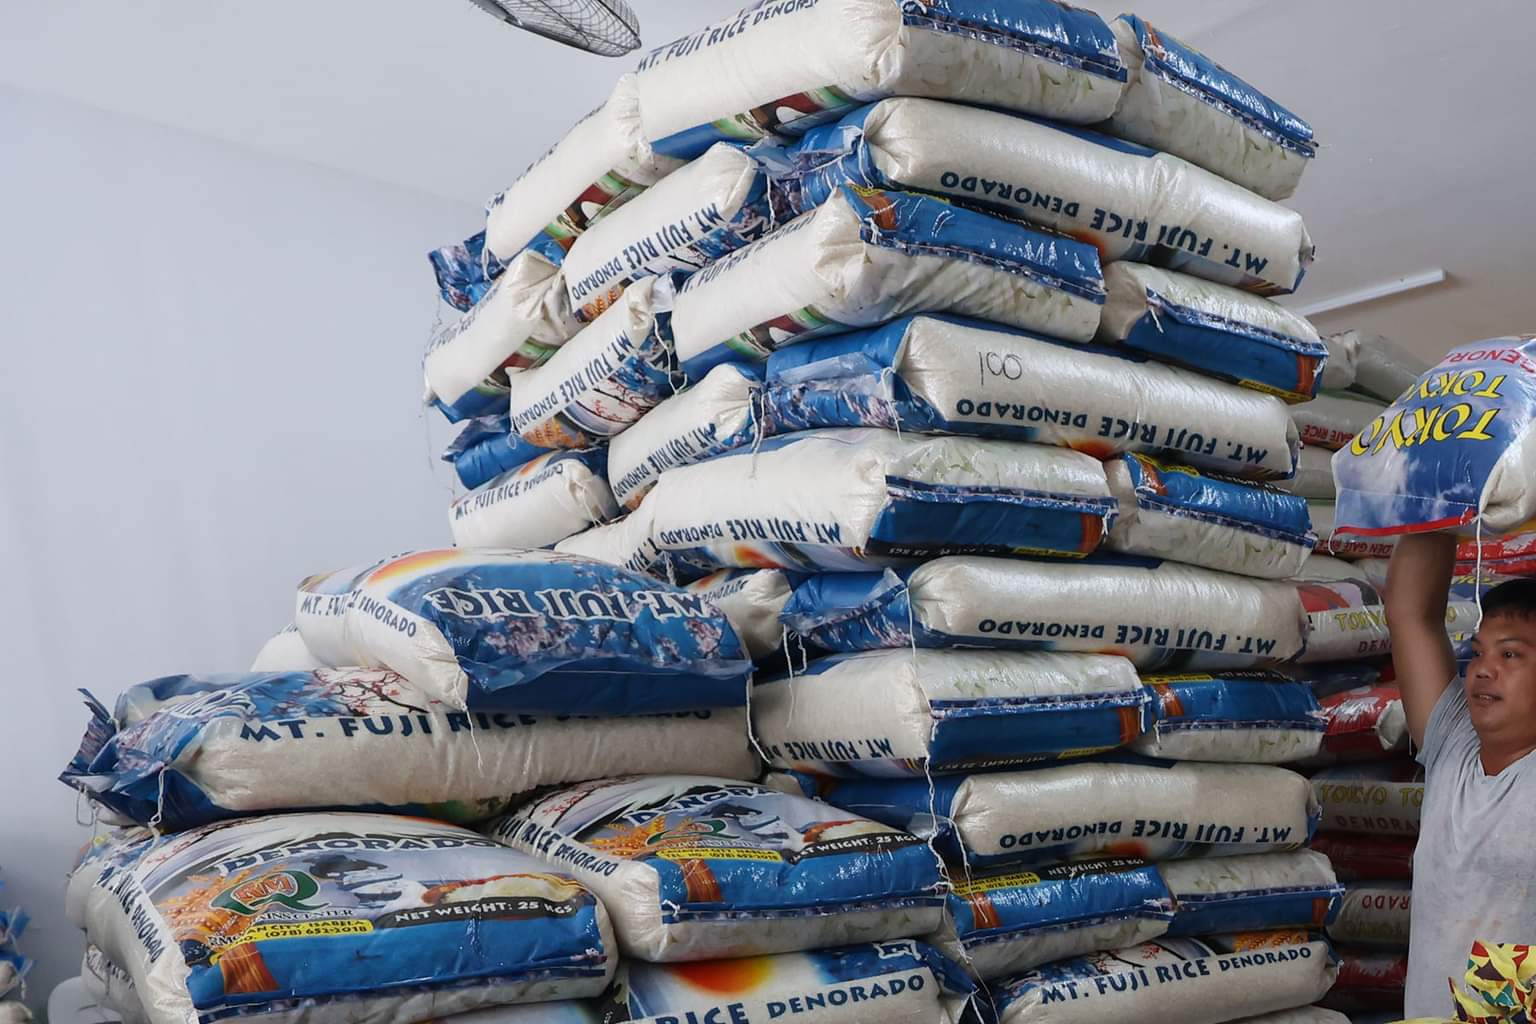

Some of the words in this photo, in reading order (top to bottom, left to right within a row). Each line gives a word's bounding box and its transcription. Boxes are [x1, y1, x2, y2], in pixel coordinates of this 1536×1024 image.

[707, 14, 751, 47] RICE
[940, 171, 1080, 218] DENORADO
[659, 219, 694, 252] FUJI
[1089, 208, 1147, 242] RICE
[622, 236, 661, 271] RICE
[1156, 225, 1213, 257] FUJI
[1223, 243, 1268, 274] MT.
[572, 258, 623, 300] DENORADO
[977, 350, 1024, 385] 100
[559, 374, 588, 403] RICE
[956, 399, 1088, 429] DENORADO
[1099, 416, 1158, 446] RICE
[1165, 428, 1217, 456] FUJI
[1350, 402, 1501, 457] TOKYO
[1227, 442, 1269, 464] MT.
[659, 522, 723, 545] DENORADO
[726, 518, 767, 541] RICE
[768, 517, 808, 543] FUJI
[359, 594, 417, 638] DENORADO
[978, 618, 1105, 639] DENORADO
[1115, 624, 1170, 646] RICE
[1176, 628, 1227, 651] FUJI
[1234, 635, 1277, 656] MT.
[239, 716, 325, 743] MT.
[338, 713, 432, 739] FUJI
[876, 836, 892, 844] 25
[1000, 820, 1123, 850] DENORADO
[1131, 820, 1186, 842] RICE
[1195, 822, 1244, 843] FUJI
[1253, 825, 1292, 843] MT.
[553, 840, 619, 877] DENORADO
[395, 910, 431, 923] NET
[435, 902, 512, 916] WEIGHT:
[517, 901, 539, 911] 25
[1041, 979, 1091, 1005] MT.
[1098, 969, 1150, 995] FUJI
[1158, 959, 1211, 983] RICE
[1219, 947, 1313, 973] DENORADO
[766, 974, 927, 1020] DENORADO
